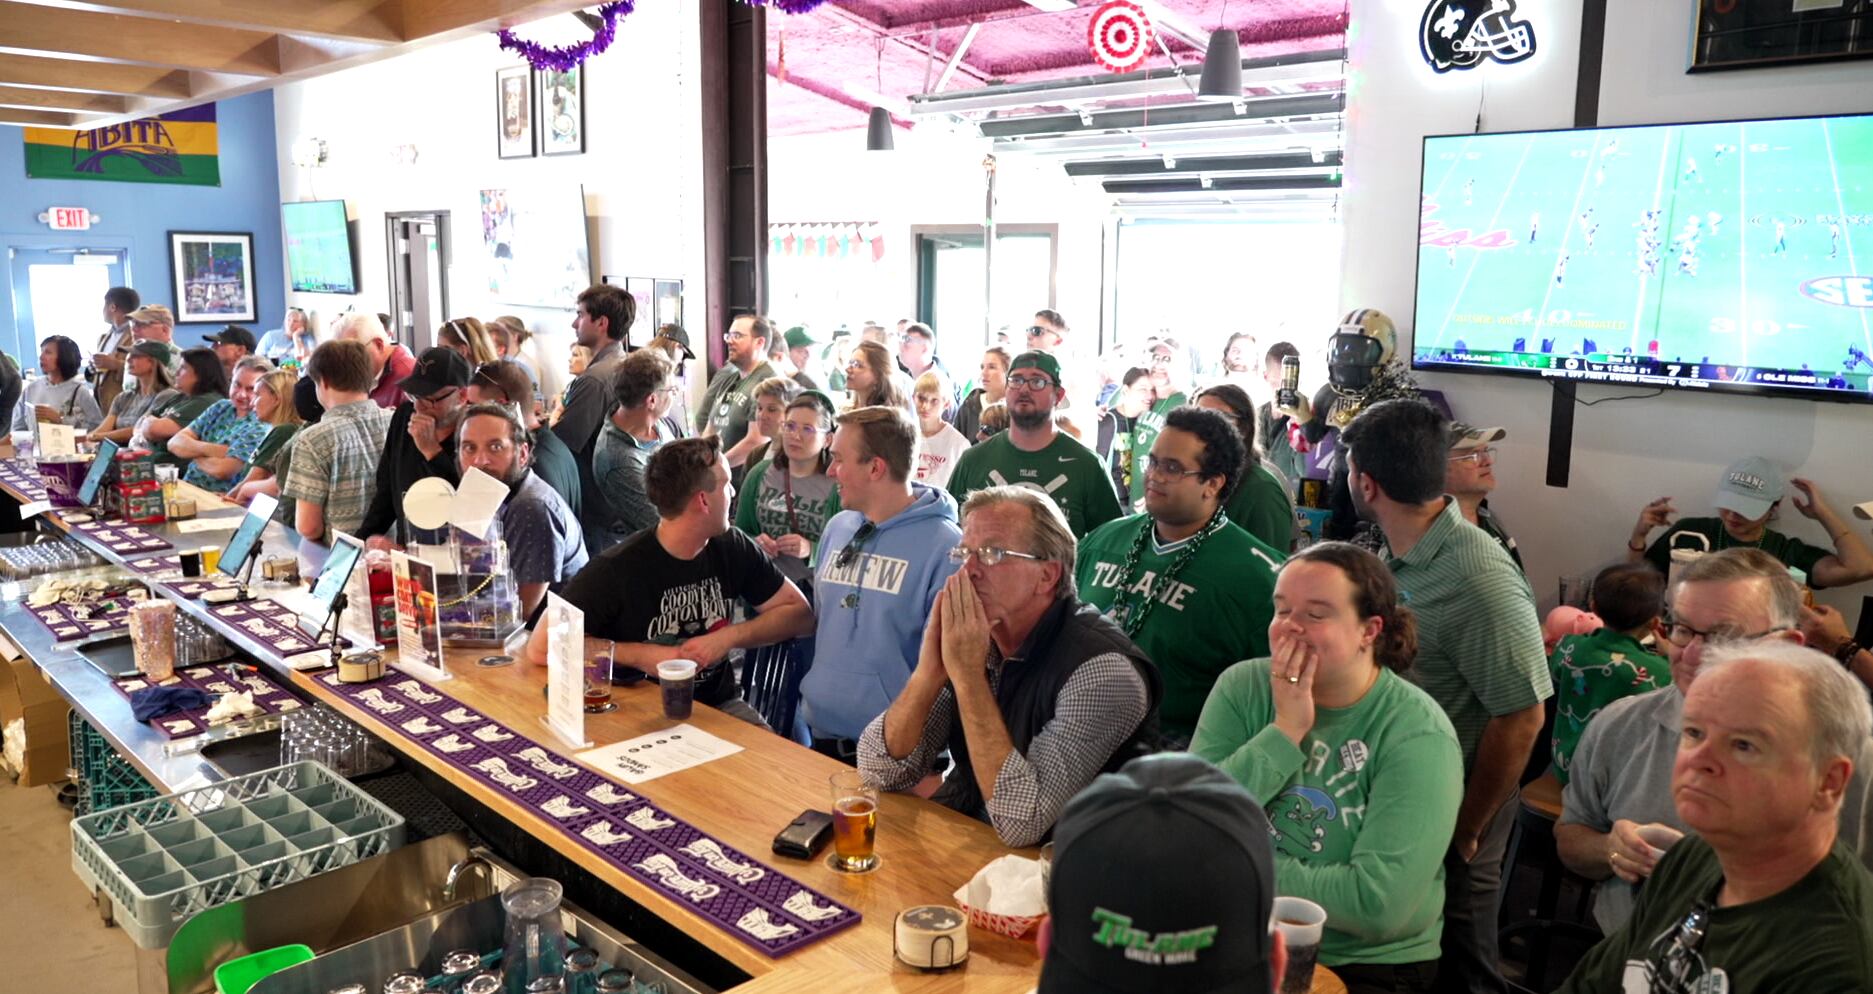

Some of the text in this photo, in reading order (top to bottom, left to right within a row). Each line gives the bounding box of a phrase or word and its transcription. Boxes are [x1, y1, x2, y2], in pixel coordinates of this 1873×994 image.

[72, 120, 174, 165] ABITA
[57, 209, 83, 227] EXIT
[1667, 365, 1681, 377] 7
[1019, 468, 1038, 478] TULANE
[1729, 471, 1766, 490] TULANE
[660, 582, 723, 615] GOODYEAR
[647, 603, 699, 640] COTTON
